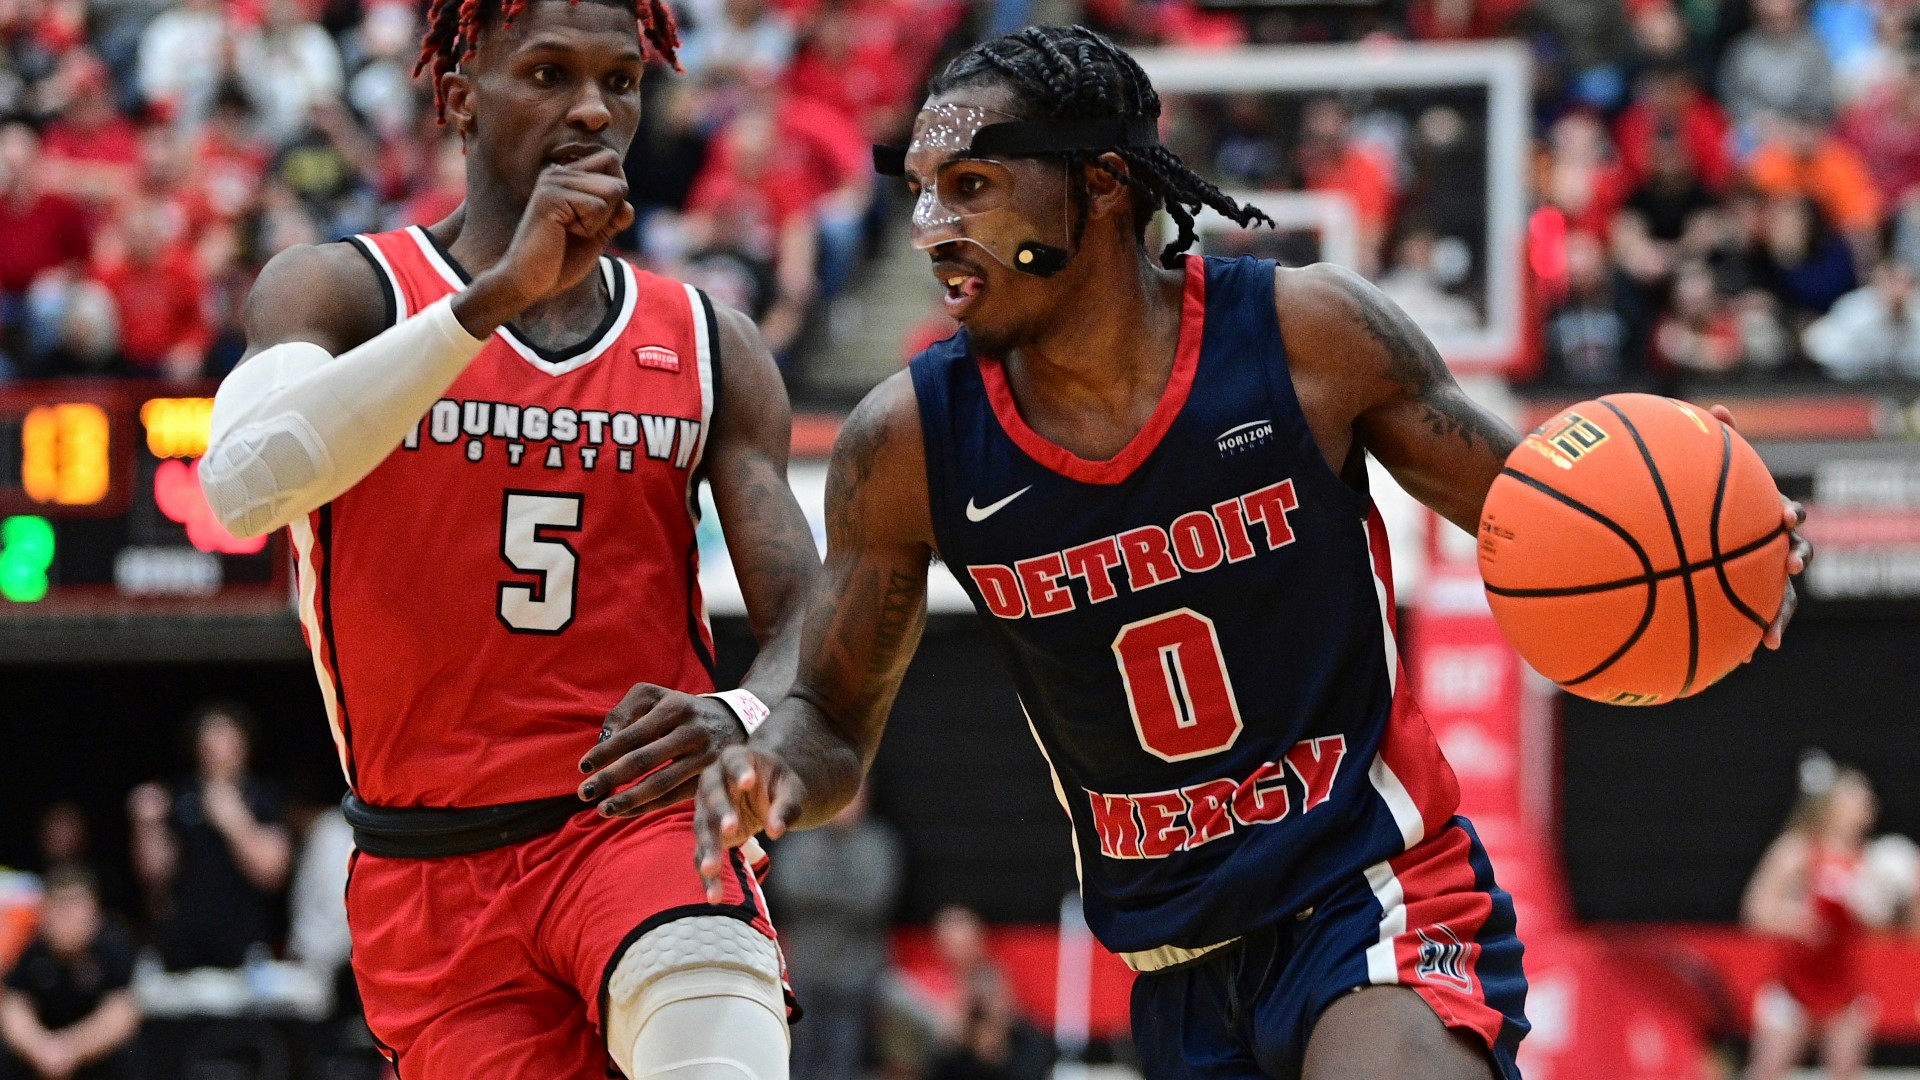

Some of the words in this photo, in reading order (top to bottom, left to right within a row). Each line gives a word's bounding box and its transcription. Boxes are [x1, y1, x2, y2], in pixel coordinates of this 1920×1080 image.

[638, 351, 679, 364] HORIZON
[465, 438, 634, 472] STATE
[1217, 424, 1273, 452] HORIZON
[497, 488, 584, 635] 5
[966, 478, 1299, 619] DETROIT
[1111, 607, 1243, 763] 0
[1083, 734, 1347, 859] MERCY
